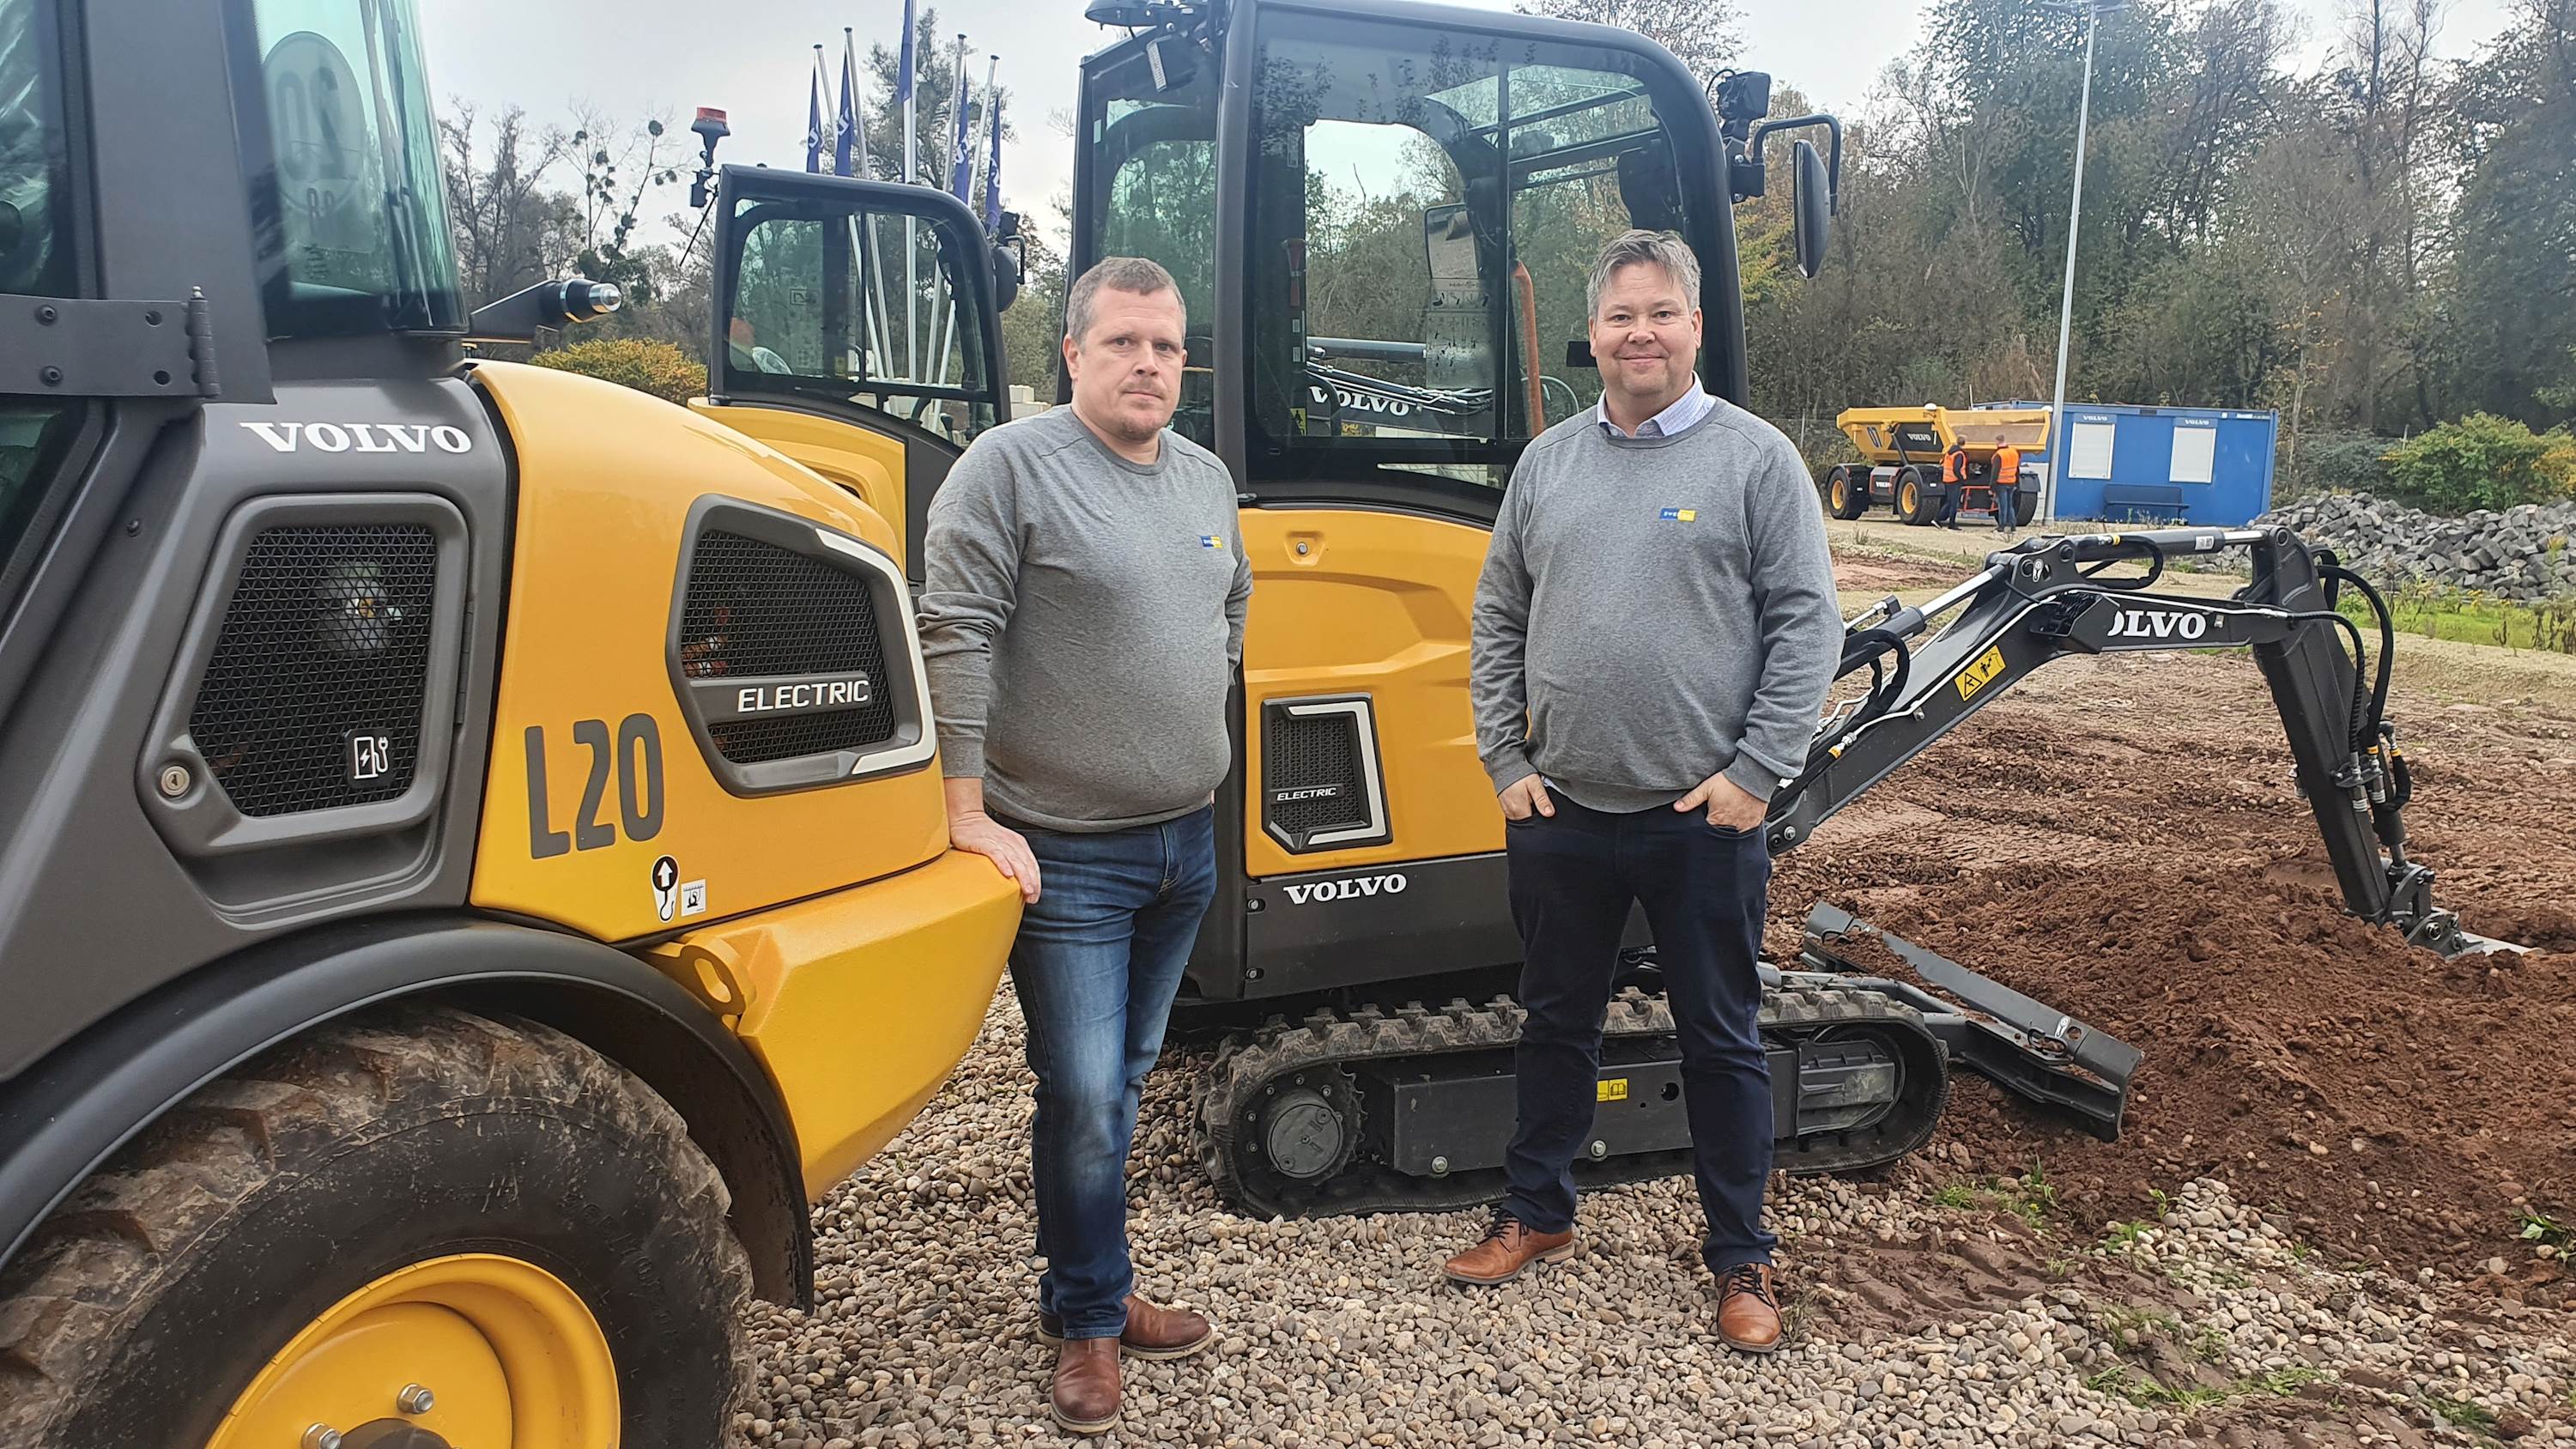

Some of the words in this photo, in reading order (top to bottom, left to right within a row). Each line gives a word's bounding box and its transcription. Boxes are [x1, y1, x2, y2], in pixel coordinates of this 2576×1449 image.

[239, 422, 472, 453] VOLVO
[2107, 610, 2207, 640] LVO
[737, 680, 870, 712] ELECTRIC
[524, 712, 664, 859] L20
[1276, 787, 1336, 801] ELECTRIC
[1282, 873, 1407, 905] VOLVO
